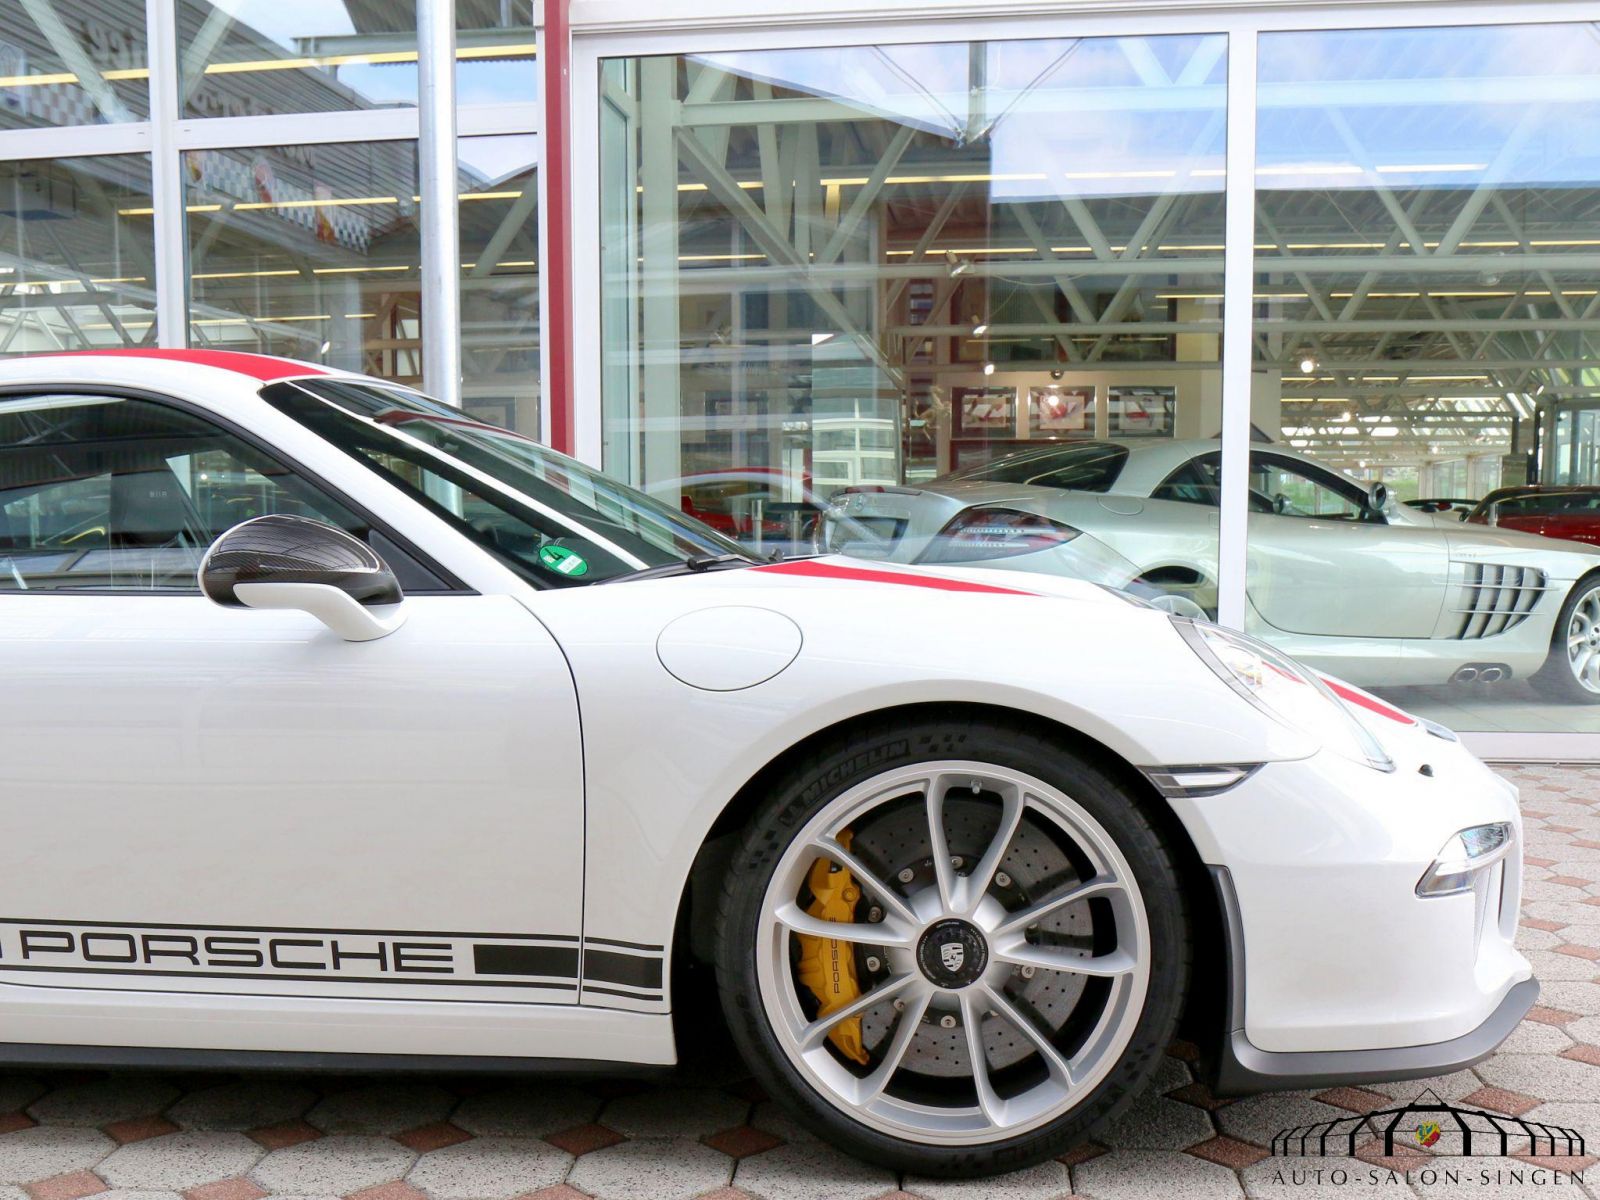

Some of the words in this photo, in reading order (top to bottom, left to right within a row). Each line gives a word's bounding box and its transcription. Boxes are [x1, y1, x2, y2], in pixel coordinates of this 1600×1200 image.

[801, 738, 911, 806] MICHELIN
[20, 930, 454, 974] PORSCHE
[829, 917, 841, 994] PORSC
